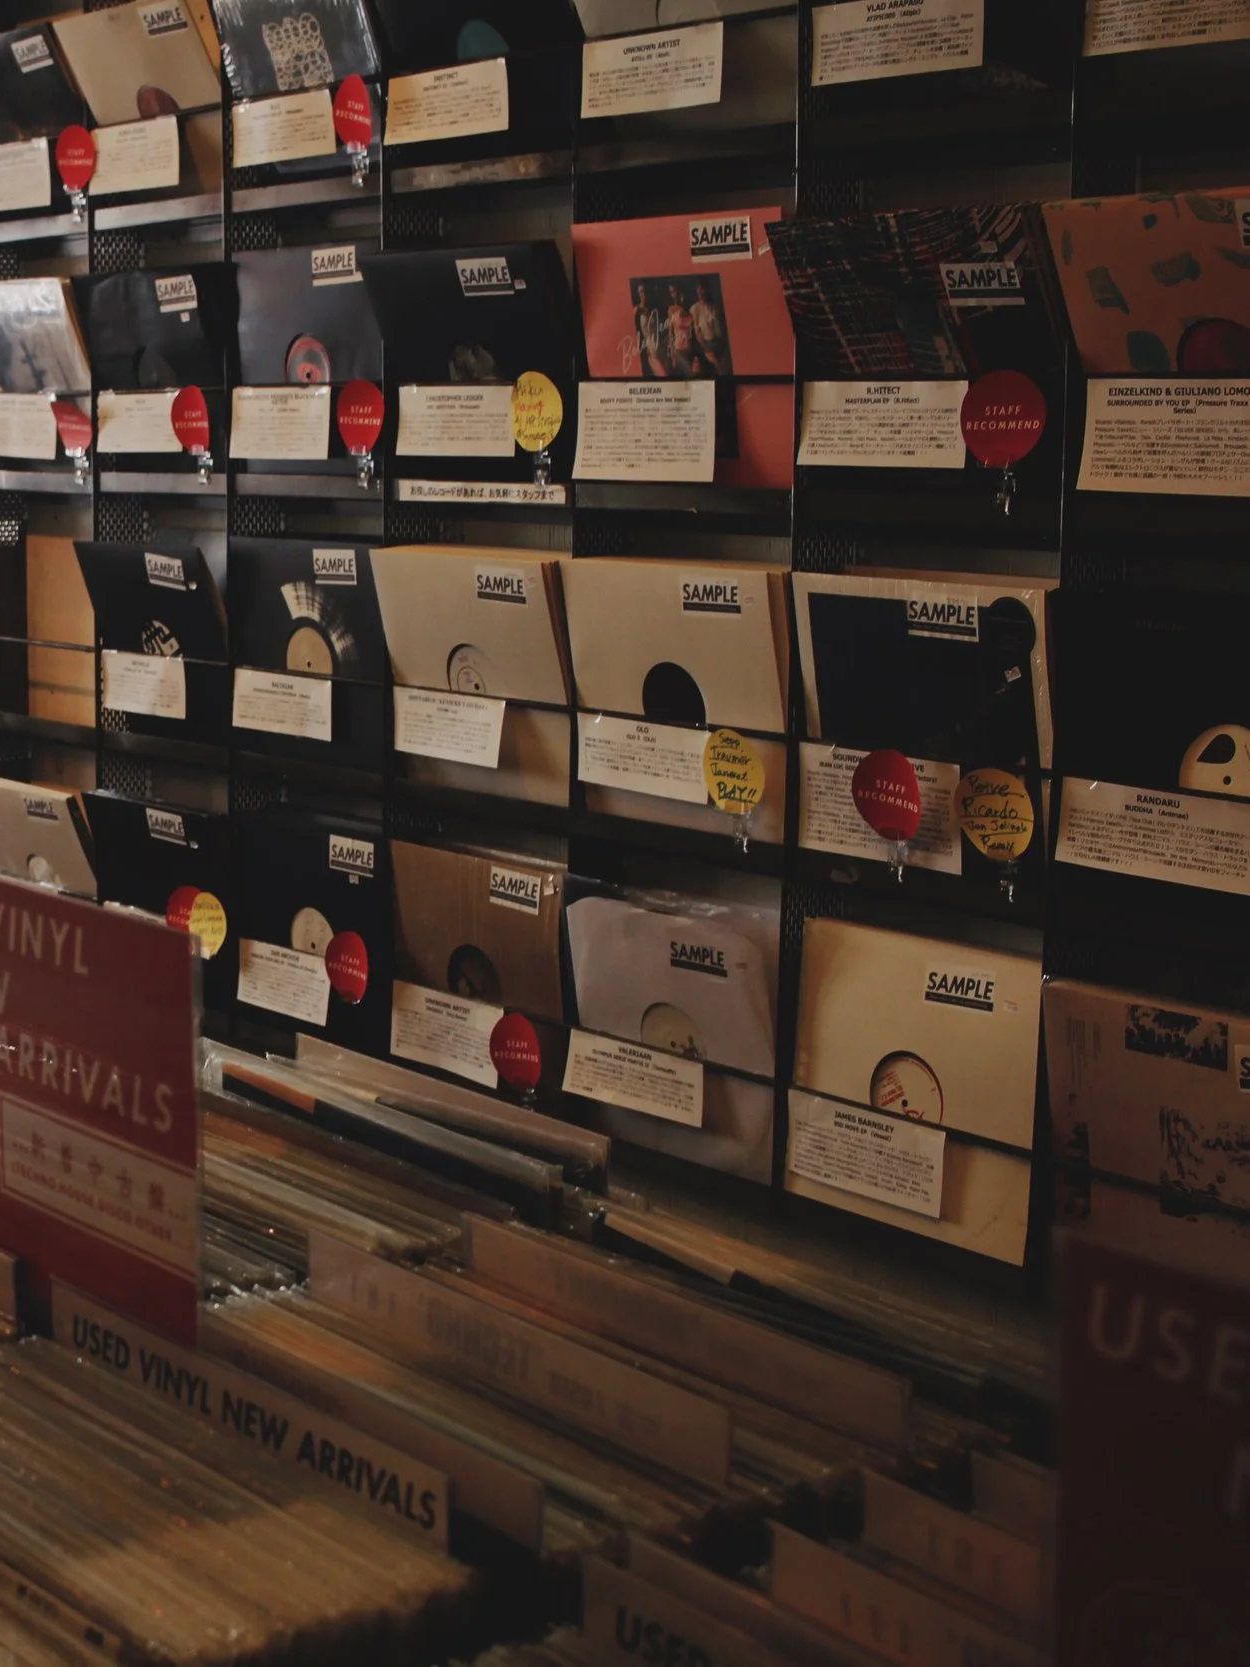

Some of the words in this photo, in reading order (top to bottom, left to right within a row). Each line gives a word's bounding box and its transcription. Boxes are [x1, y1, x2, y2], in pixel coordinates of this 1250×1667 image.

[867, 2, 887, 13] VLAD
[143, 7, 182, 29] SAMPLE
[15, 40, 48, 60] SAMPLE
[623, 43, 656, 55] UNKNOWN
[657, 39, 681, 49] ARTIST
[347, 101, 364, 111] STAFF
[335, 109, 371, 126] RECOMMEND
[691, 223, 748, 246] SAMPLE
[313, 252, 353, 271] SAMPLE
[461, 263, 511, 287] SAMPLE
[945, 267, 1018, 290] SAMPLE
[157, 279, 194, 299] SAMPLE
[866, 386, 901, 396] R.HITECT
[1108, 387, 1163, 397] EINZELKIND
[1165, 387, 1172, 396] &
[1174, 387, 1221, 397] GIULIANO
[845, 397, 881, 405] MASTERPLAN
[1195, 399, 1227, 407] (Pressure
[184, 410, 202, 419] STAFF
[351, 405, 373, 415] STAFF
[984, 405, 1022, 416] STAFF
[1173, 407, 1197, 415] Series)
[339, 415, 382, 427] RECOMMEND
[966, 419, 1040, 431] RECOMMEND
[148, 558, 183, 579] SAMPLE
[315, 556, 355, 573] SAMPLE
[477, 573, 525, 596] SAMPLE
[682, 582, 739, 605] SAMPLE
[907, 601, 976, 627] SAMPLE
[875, 778, 907, 795] STAFF
[916, 775, 938, 785] actory)
[23, 797, 55, 816] SAMPLE
[858, 788, 919, 814] RECOMMEND
[962, 798, 1019, 819] Ricardo
[1124, 804, 1153, 814] BUDDHA
[1136, 794, 1181, 809] RANDARU
[149, 815, 185, 834] SAMPLE
[331, 843, 375, 867] SAMPLE
[491, 872, 539, 900] SAMPLE
[340, 953, 360, 966] STAFF
[670, 940, 726, 969] SAMPLE
[328, 963, 367, 981] RECOMMEND
[926, 970, 996, 1001] SAMPLE
[506, 1039, 528, 1049] STAFF
[494, 1051, 539, 1063] RECOMMEND
[834, 1110, 857, 1124] JAMES
[858, 1117, 895, 1133] BARNSLEY
[72, 1313, 131, 1371] USED
[139, 1347, 212, 1416] VINYL
[221, 1387, 290, 1453] NEW
[295, 1430, 437, 1531] ARRIVALS
